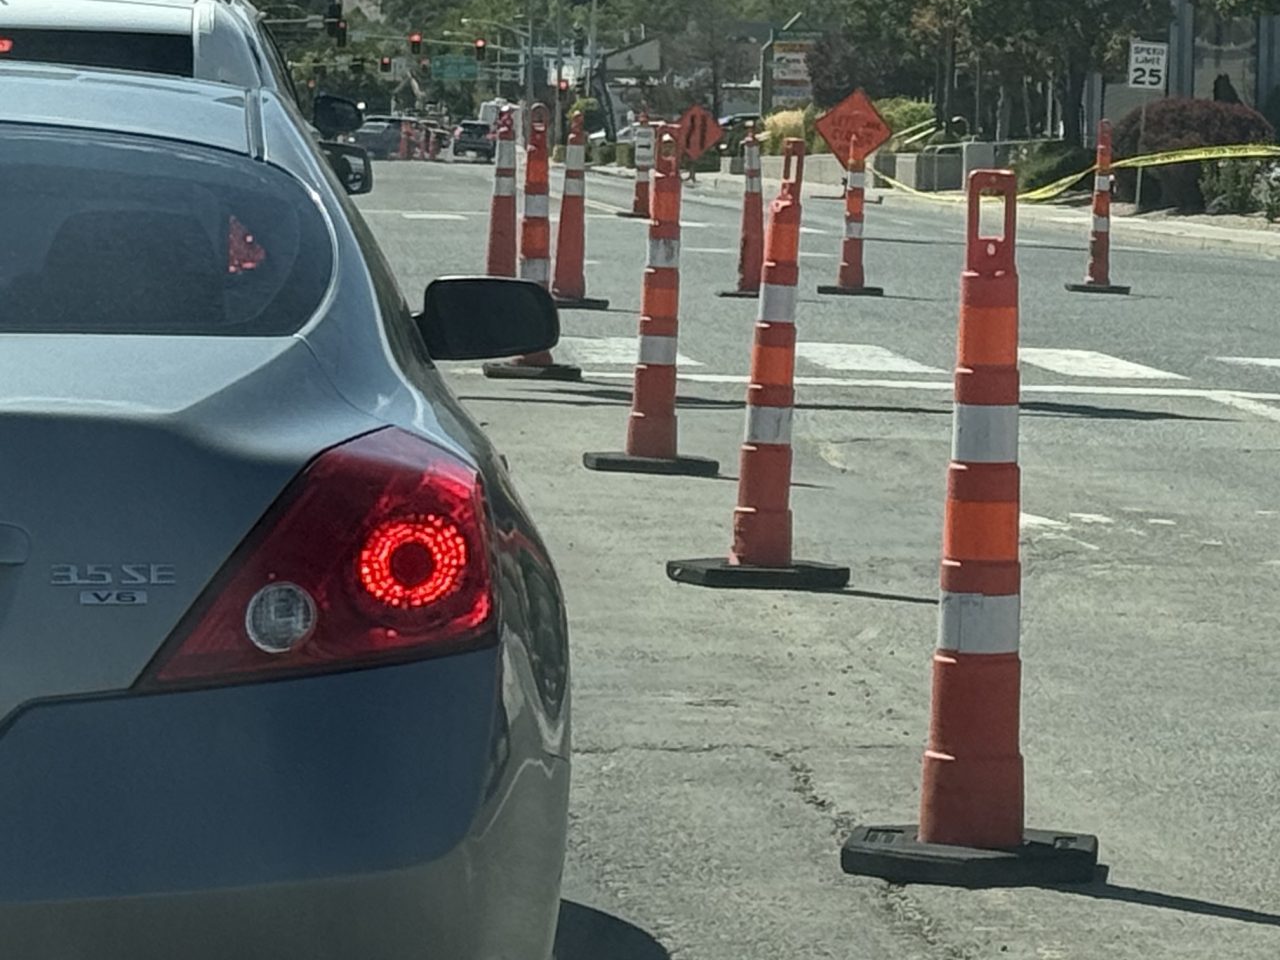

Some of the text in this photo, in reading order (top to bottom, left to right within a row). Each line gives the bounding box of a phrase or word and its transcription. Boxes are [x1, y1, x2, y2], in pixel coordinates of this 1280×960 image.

[1132, 67, 1162, 86] 25
[120, 564, 176, 585] SE
[92, 592, 137, 603] V6
